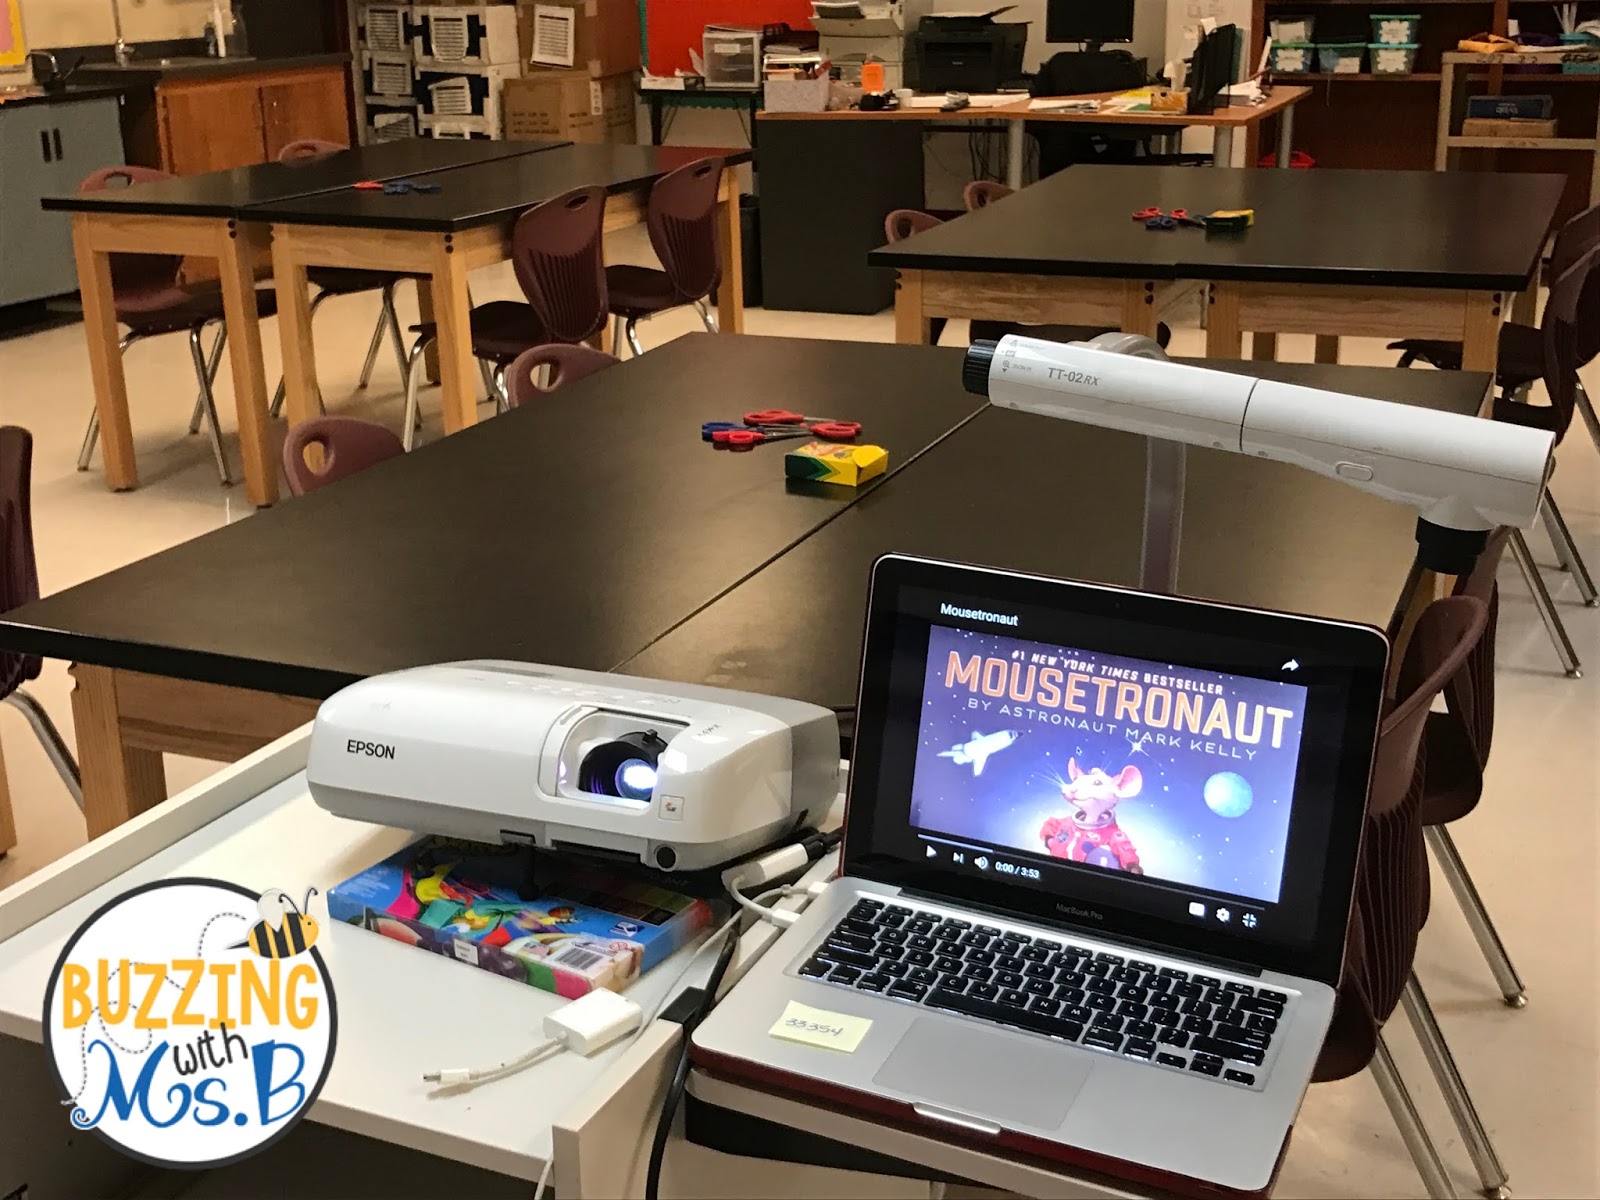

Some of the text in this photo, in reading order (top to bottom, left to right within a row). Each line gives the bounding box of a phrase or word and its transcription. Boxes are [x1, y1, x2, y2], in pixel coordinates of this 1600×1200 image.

[940, 603, 1019, 626] Mousetronaut
[1011, 650, 1223, 695] #1 NEW YORK TIMES BESTSELLER
[945, 650, 1294, 749] MOUSETRONAUT
[968, 698, 1257, 760] BY ASTRONAUT MARK KELLY
[347, 739, 395, 760] EPSON
[995, 861, 1014, 874] 0:00
[1020, 867, 1040, 879] 3:53
[1056, 903, 1104, 921] MacBook Pro
